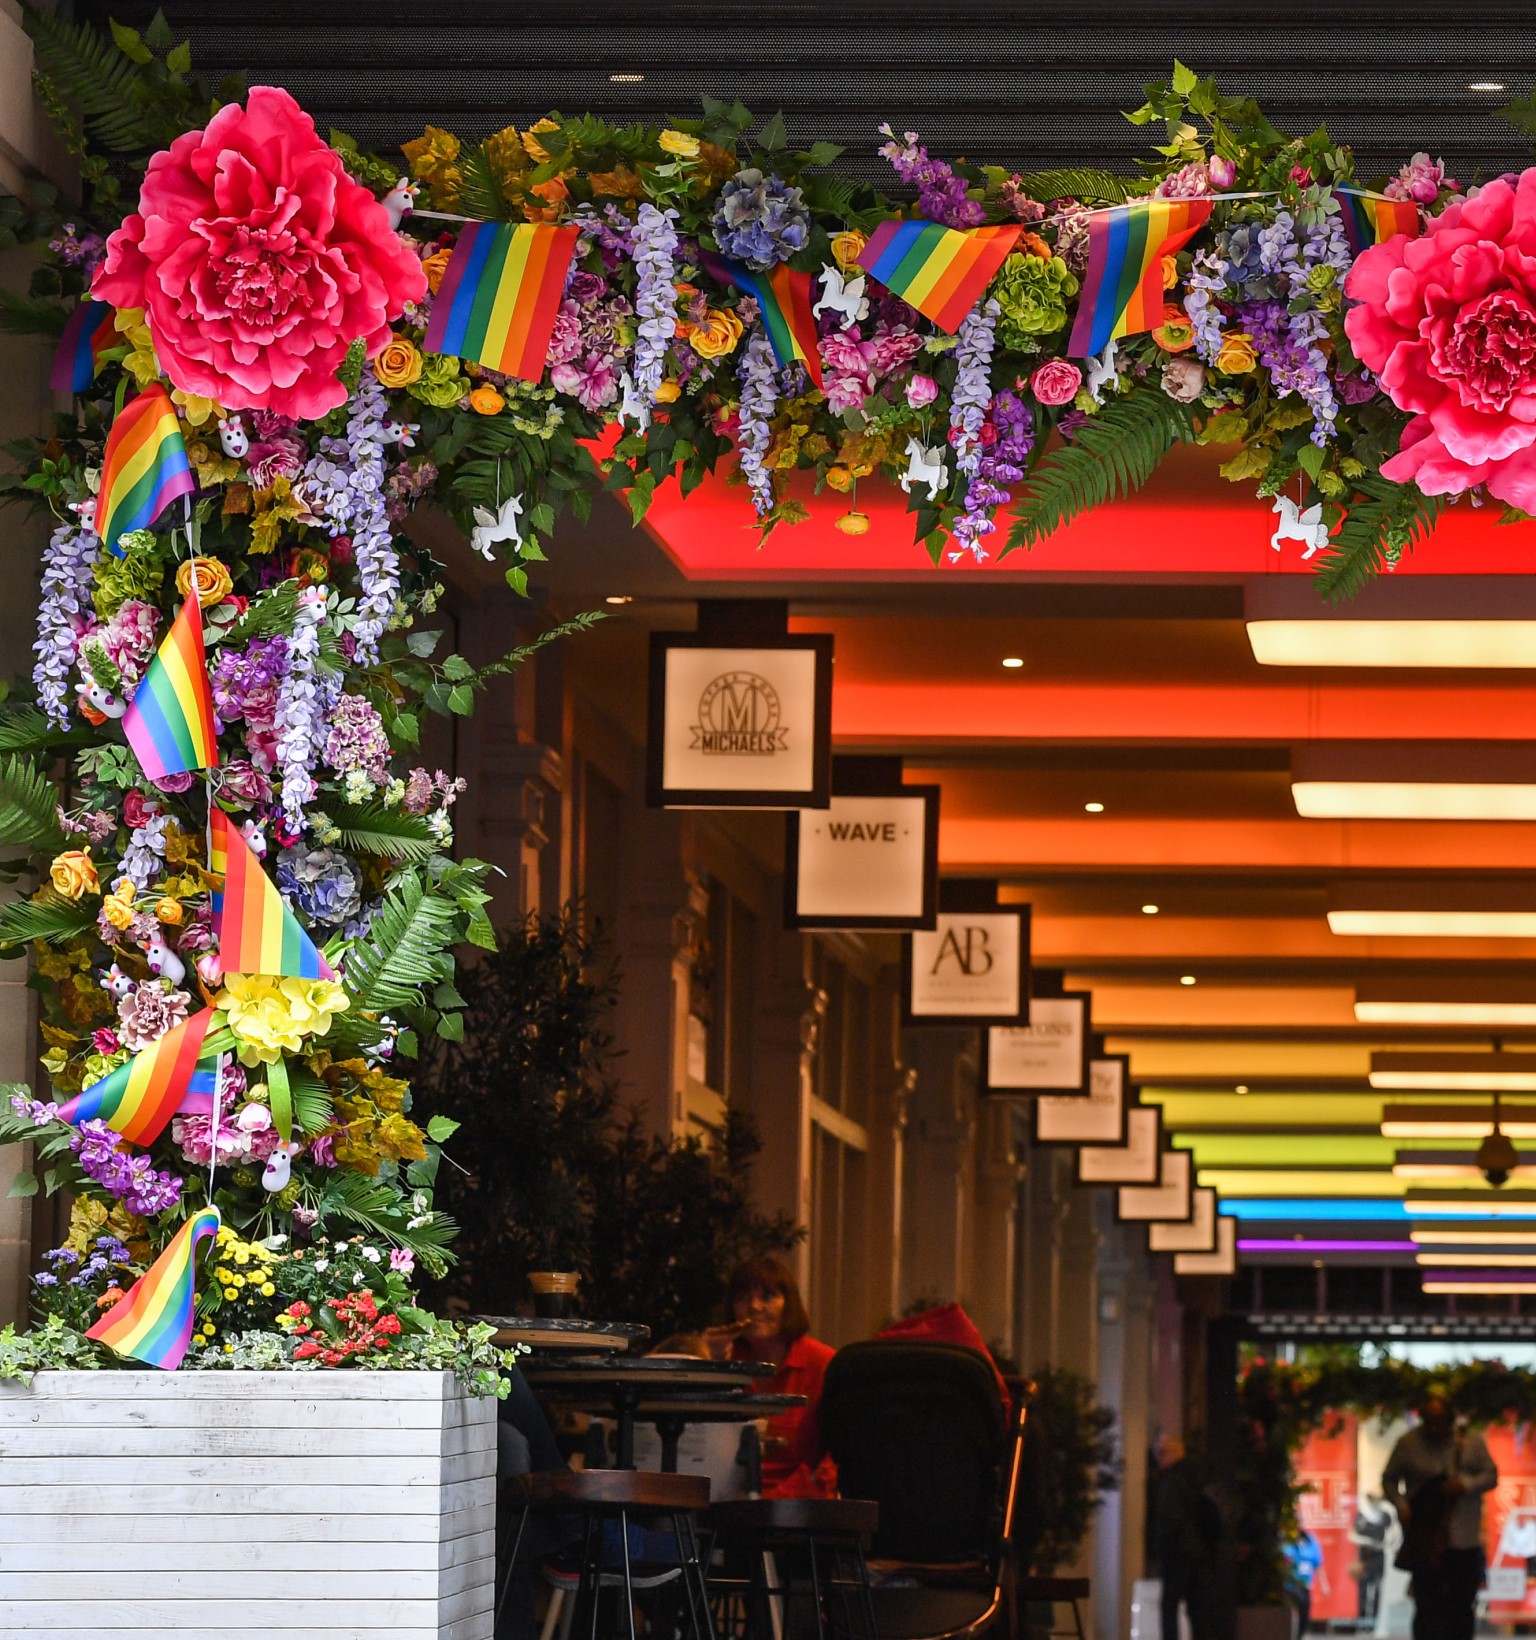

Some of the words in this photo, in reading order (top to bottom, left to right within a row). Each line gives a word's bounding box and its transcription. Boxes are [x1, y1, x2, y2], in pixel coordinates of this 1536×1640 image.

[702, 734, 776, 752] MICHAELS
[828, 822, 896, 841] WAVE
[930, 927, 993, 976] AB
